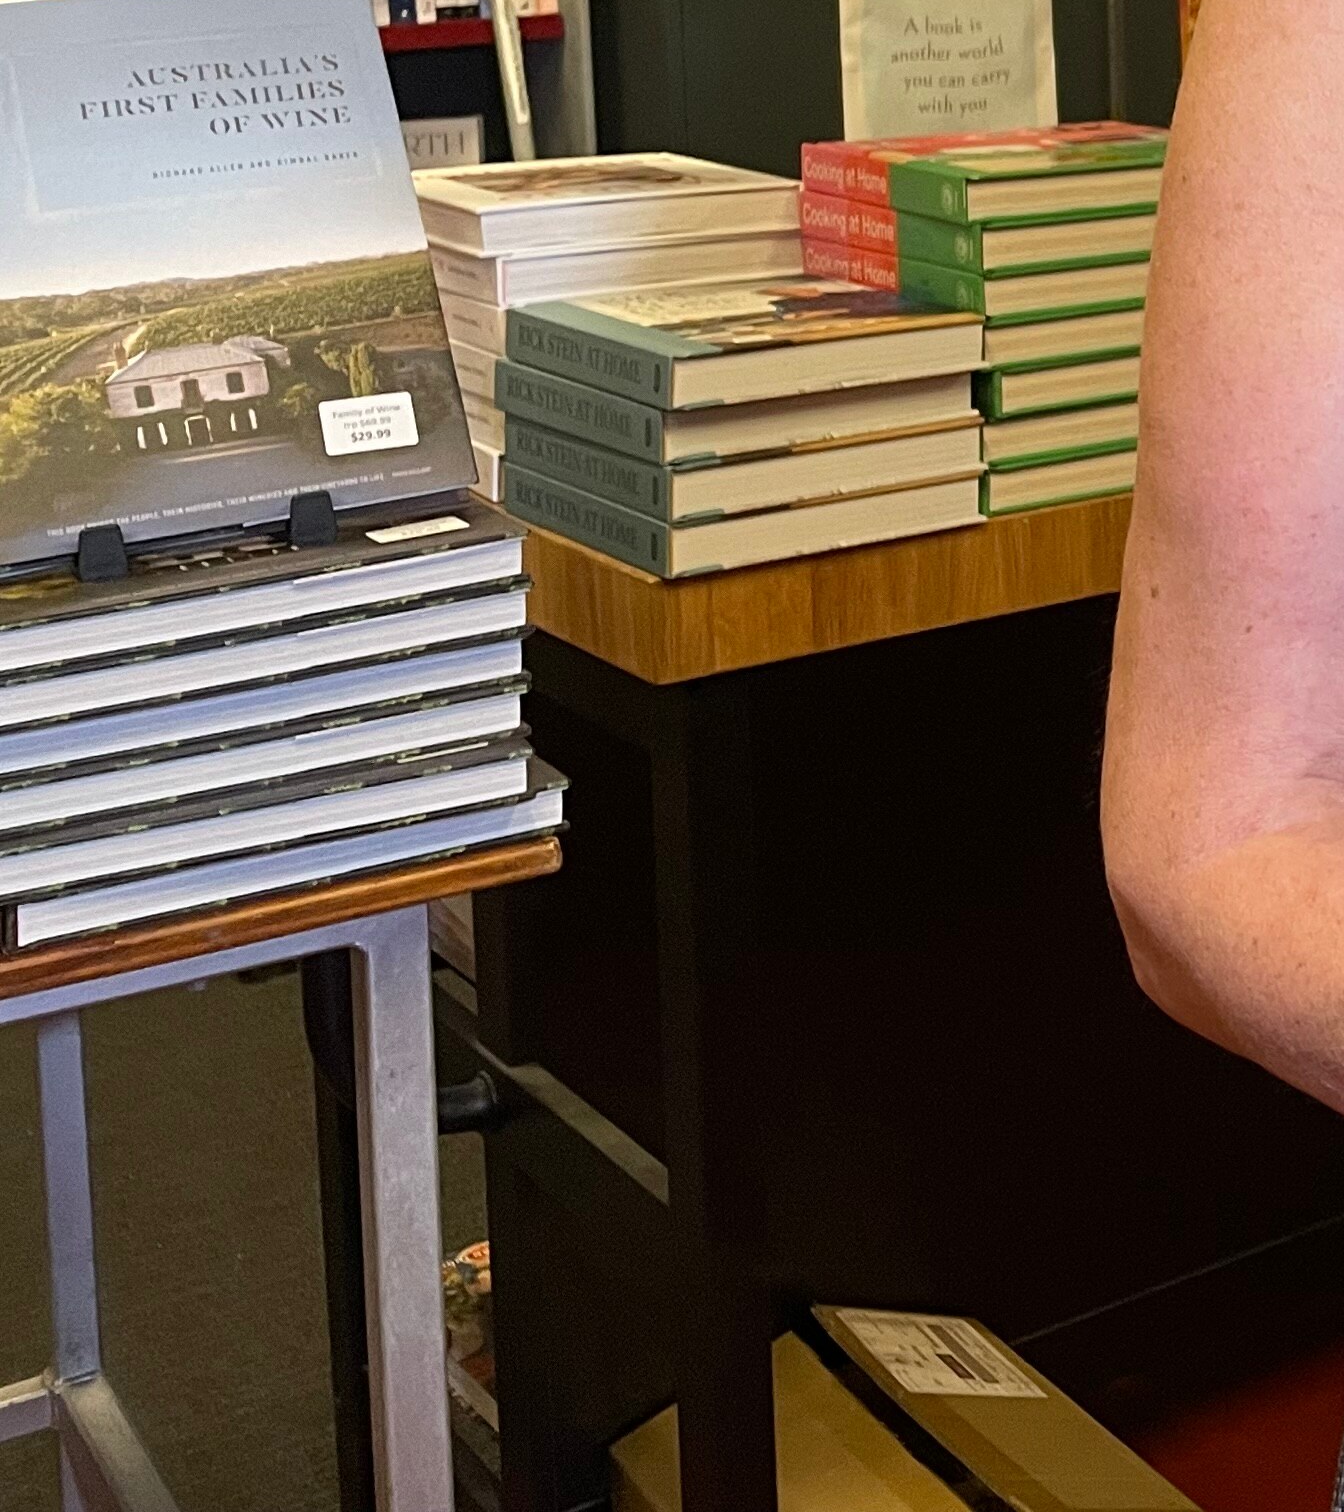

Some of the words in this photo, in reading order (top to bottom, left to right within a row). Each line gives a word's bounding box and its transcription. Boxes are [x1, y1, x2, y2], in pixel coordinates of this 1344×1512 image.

[904, 17, 919, 35] A
[925, 15, 963, 35] book
[970, 18, 982, 34] is
[891, 40, 950, 64] another
[959, 34, 1003, 60] world
[126, 53, 340, 89] AUSTRALIA'S
[904, 75, 932, 95] you
[939, 75, 965, 88] can
[972, 69, 1010, 87] carry
[80, 93, 178, 121] FIRST
[191, 79, 346, 110] FAMILIES
[918, 94, 953, 113] with
[960, 98, 987, 119] you
[209, 114, 251, 136] OF
[261, 105, 352, 130] WINE
[804, 156, 844, 188] Cooking
[845, 167, 856, 184] at
[857, 168, 887, 194] Home
[803, 203, 846, 236] Cooking
[849, 213, 860, 233] at
[862, 215, 894, 241] Home
[805, 248, 849, 281] Cooking
[851, 260, 862, 281] at
[864, 259, 897, 287] Home
[518, 324, 545, 354] RICK
[546, 336, 583, 362] STEIN
[587, 346, 601, 372] AT
[604, 351, 642, 385] HOME
[507, 375, 536, 402] RICK
[332, 409, 363, 419] Family
[365, 406, 375, 415] of
[351, 428, 391, 443] $29.99
